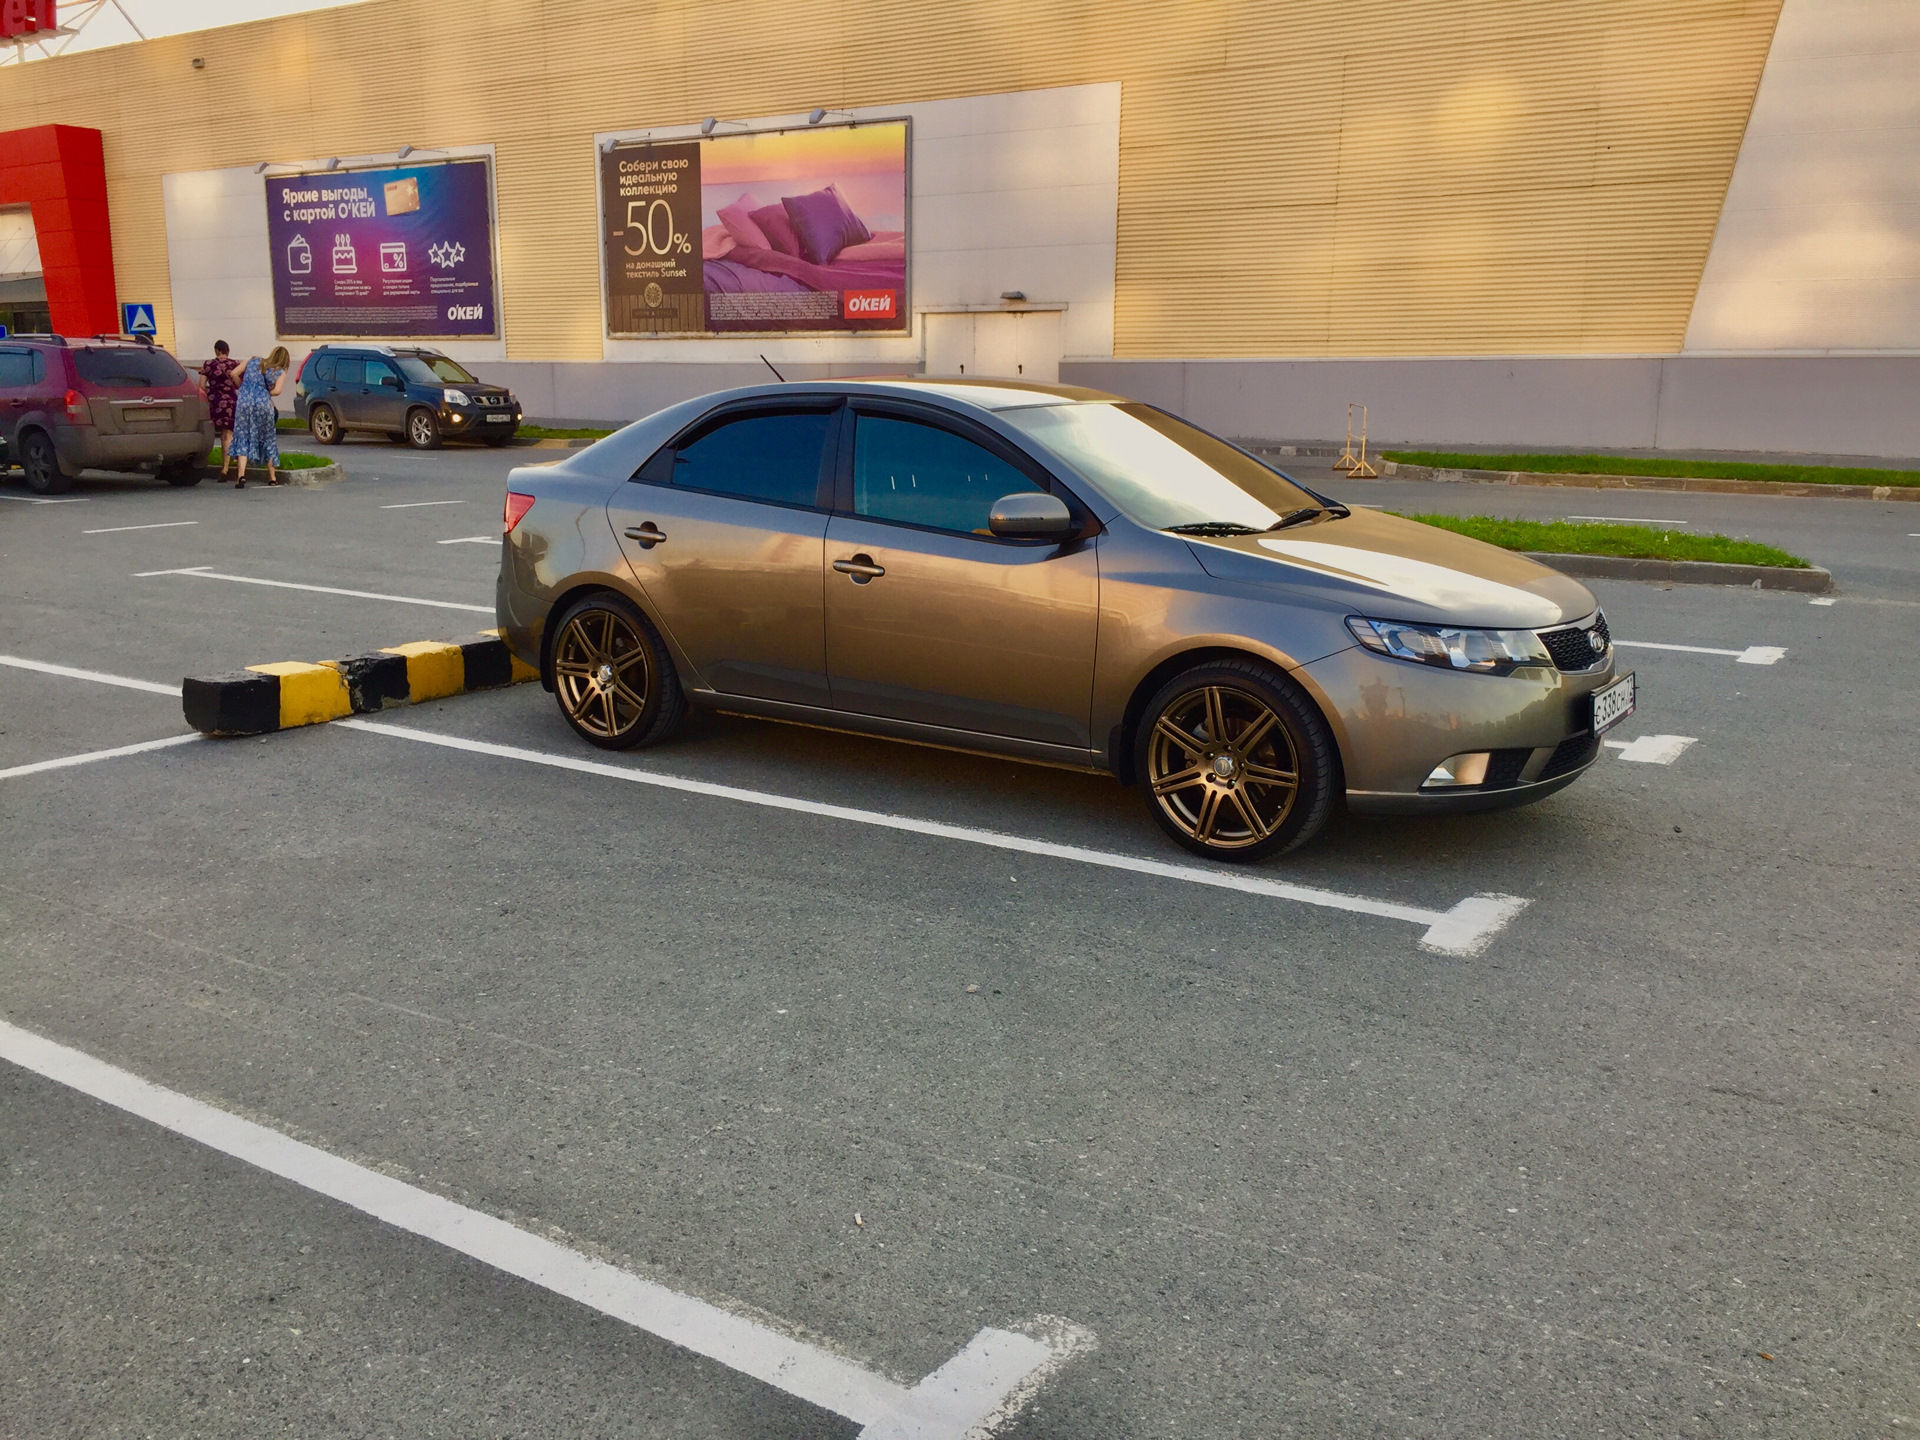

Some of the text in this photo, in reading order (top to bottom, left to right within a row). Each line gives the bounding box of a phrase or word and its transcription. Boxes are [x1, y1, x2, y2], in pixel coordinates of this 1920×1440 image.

[619, 159, 689, 173] Собери свою
[619, 172, 678, 186] идеальную
[282, 187, 367, 207] Яркие выгоды
[619, 184, 678, 197] коллекцию
[283, 197, 376, 224] с картой О'КЕЙ
[635, 258, 676, 270] домашний
[661, 268, 687, 277] Sunset
